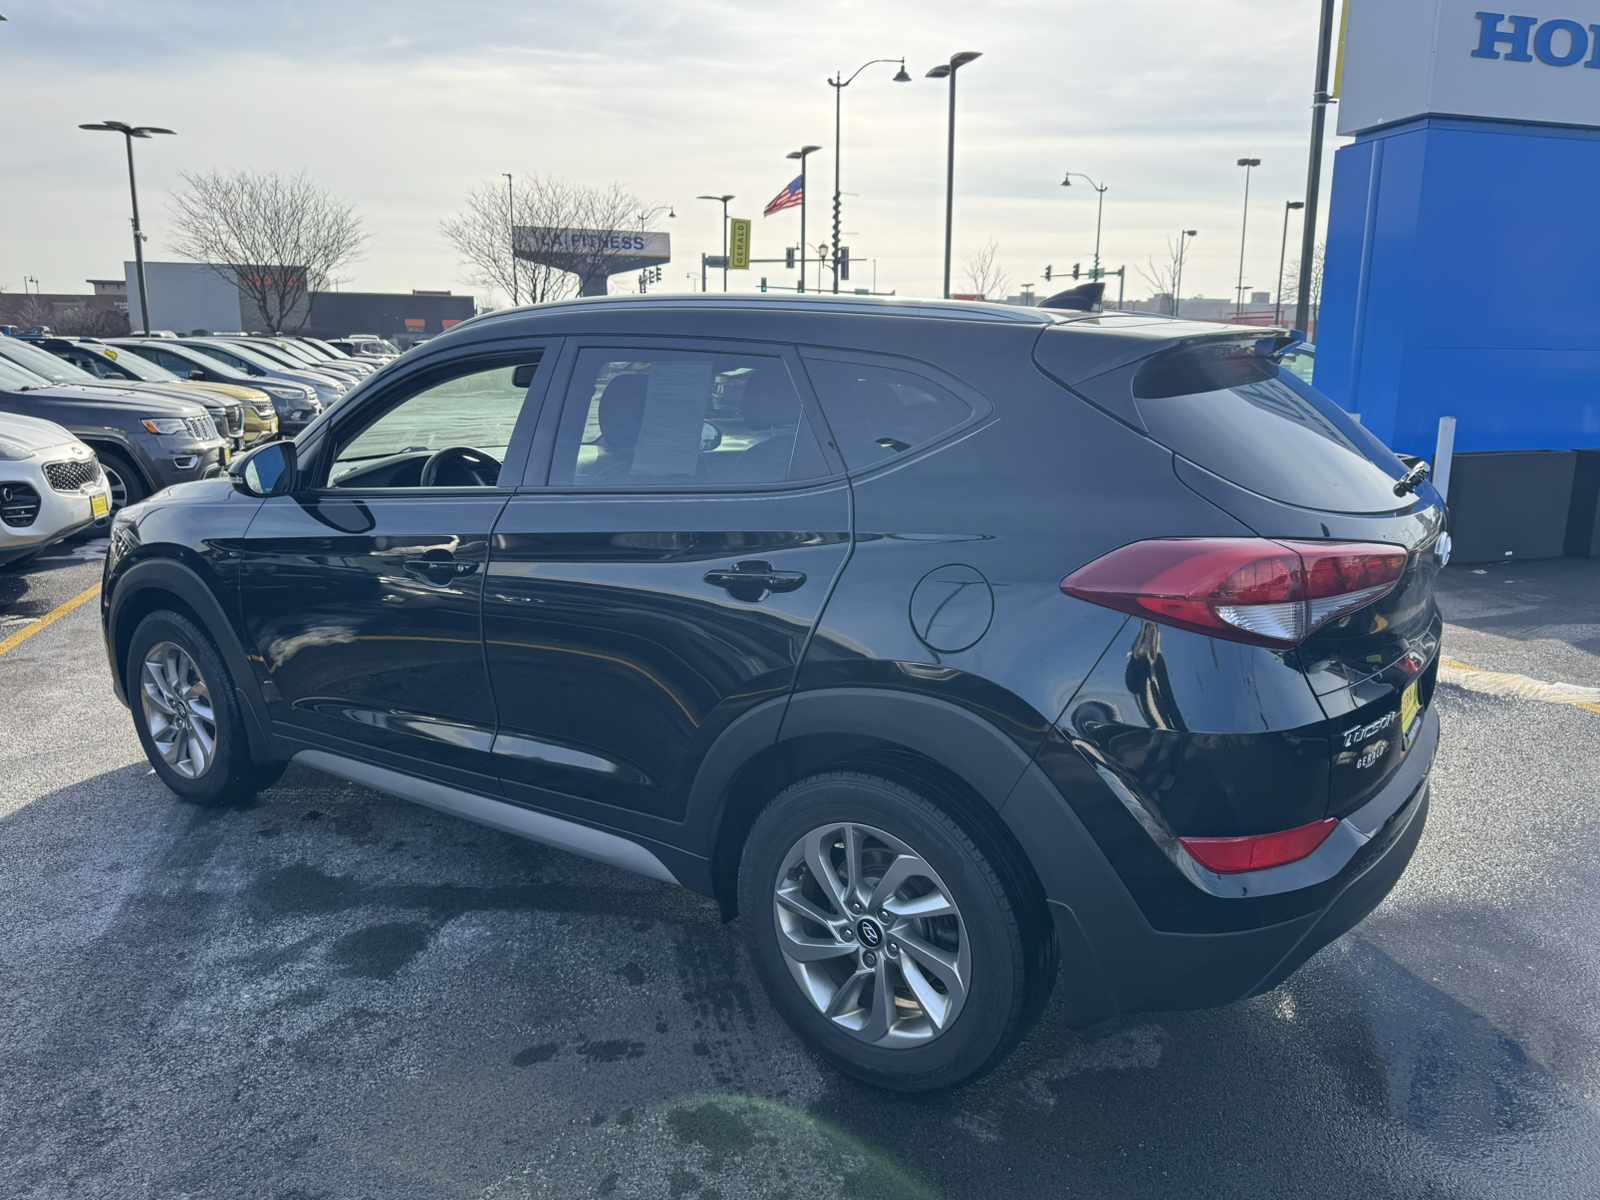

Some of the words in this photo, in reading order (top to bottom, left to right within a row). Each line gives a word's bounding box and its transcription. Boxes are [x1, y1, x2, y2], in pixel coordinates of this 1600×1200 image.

[1471, 11, 1600, 69] HO
[571, 234, 644, 250] FITNESS
[736, 224, 745, 263] GERALD
[1357, 746, 1384, 769] GERALD
